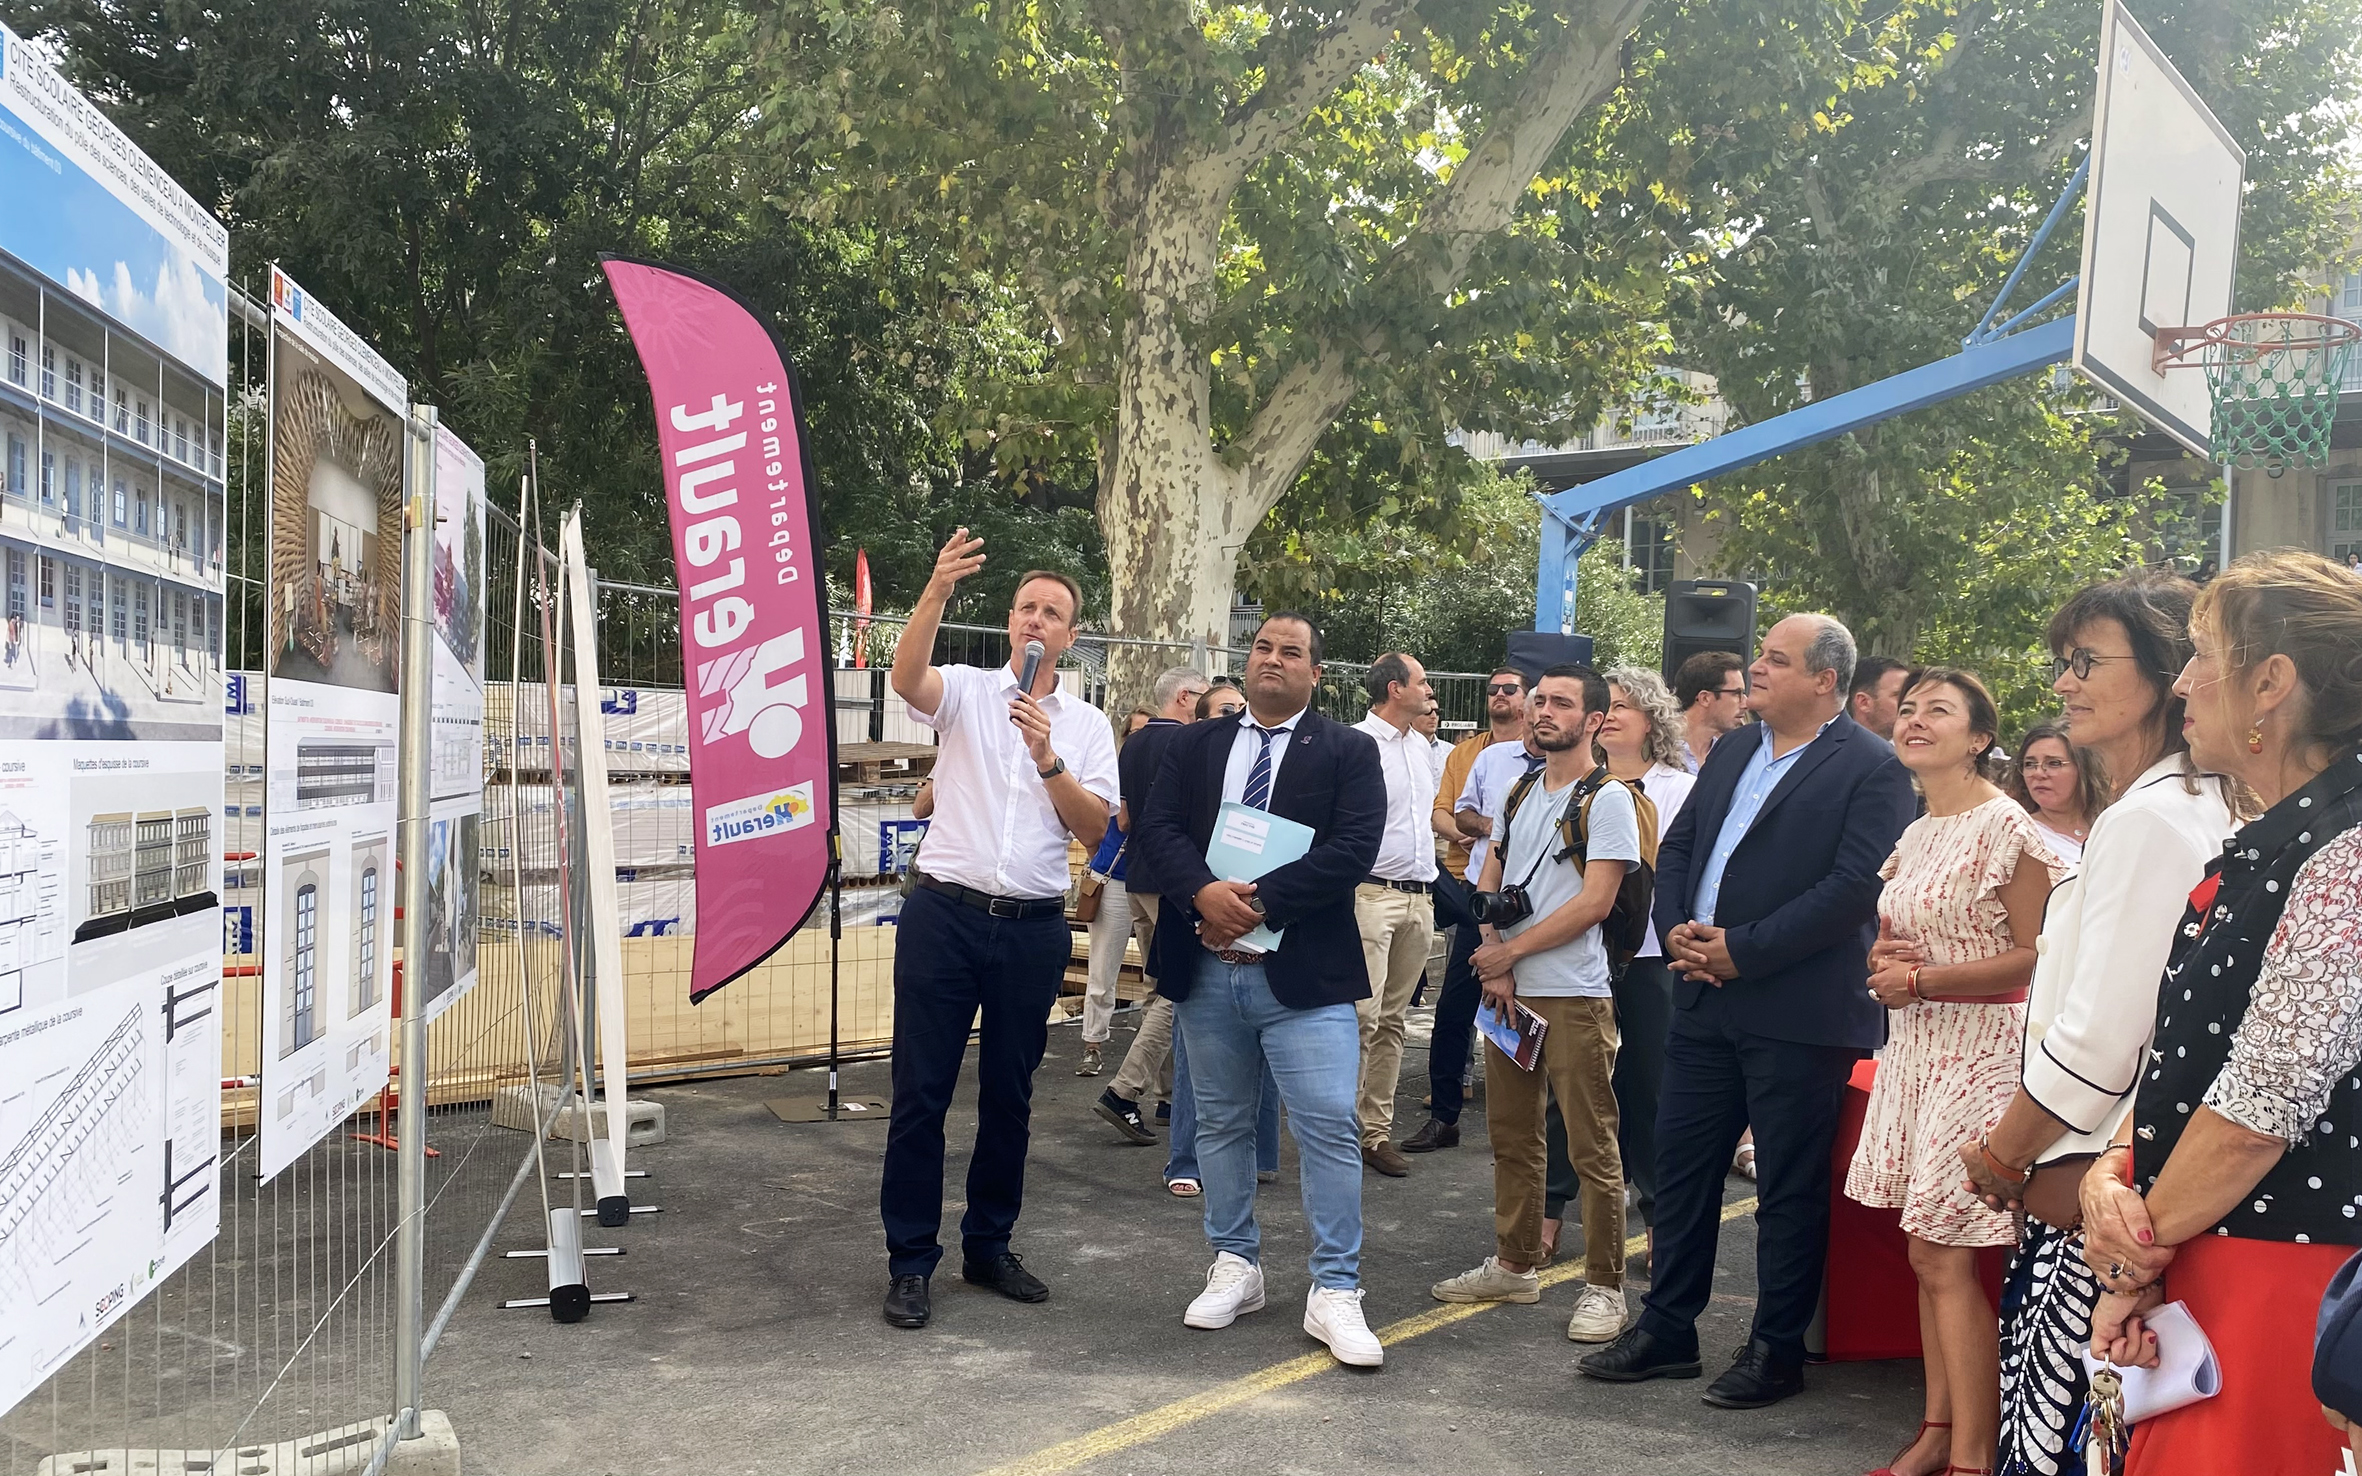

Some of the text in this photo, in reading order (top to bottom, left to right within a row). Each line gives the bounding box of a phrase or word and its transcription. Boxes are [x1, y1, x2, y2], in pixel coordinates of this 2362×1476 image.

[10, 71, 63, 131] Restructuration
[65, 120, 73, 138] du
[10, 42, 34, 80] CITE
[36, 65, 84, 123] SCOLAIRE
[86, 110, 126, 160] GEORGES
[128, 148, 178, 206] CLEMENCEAU
[184, 199, 226, 251] MONTPELLIER
[72, 758, 98, 772] Maquettes
